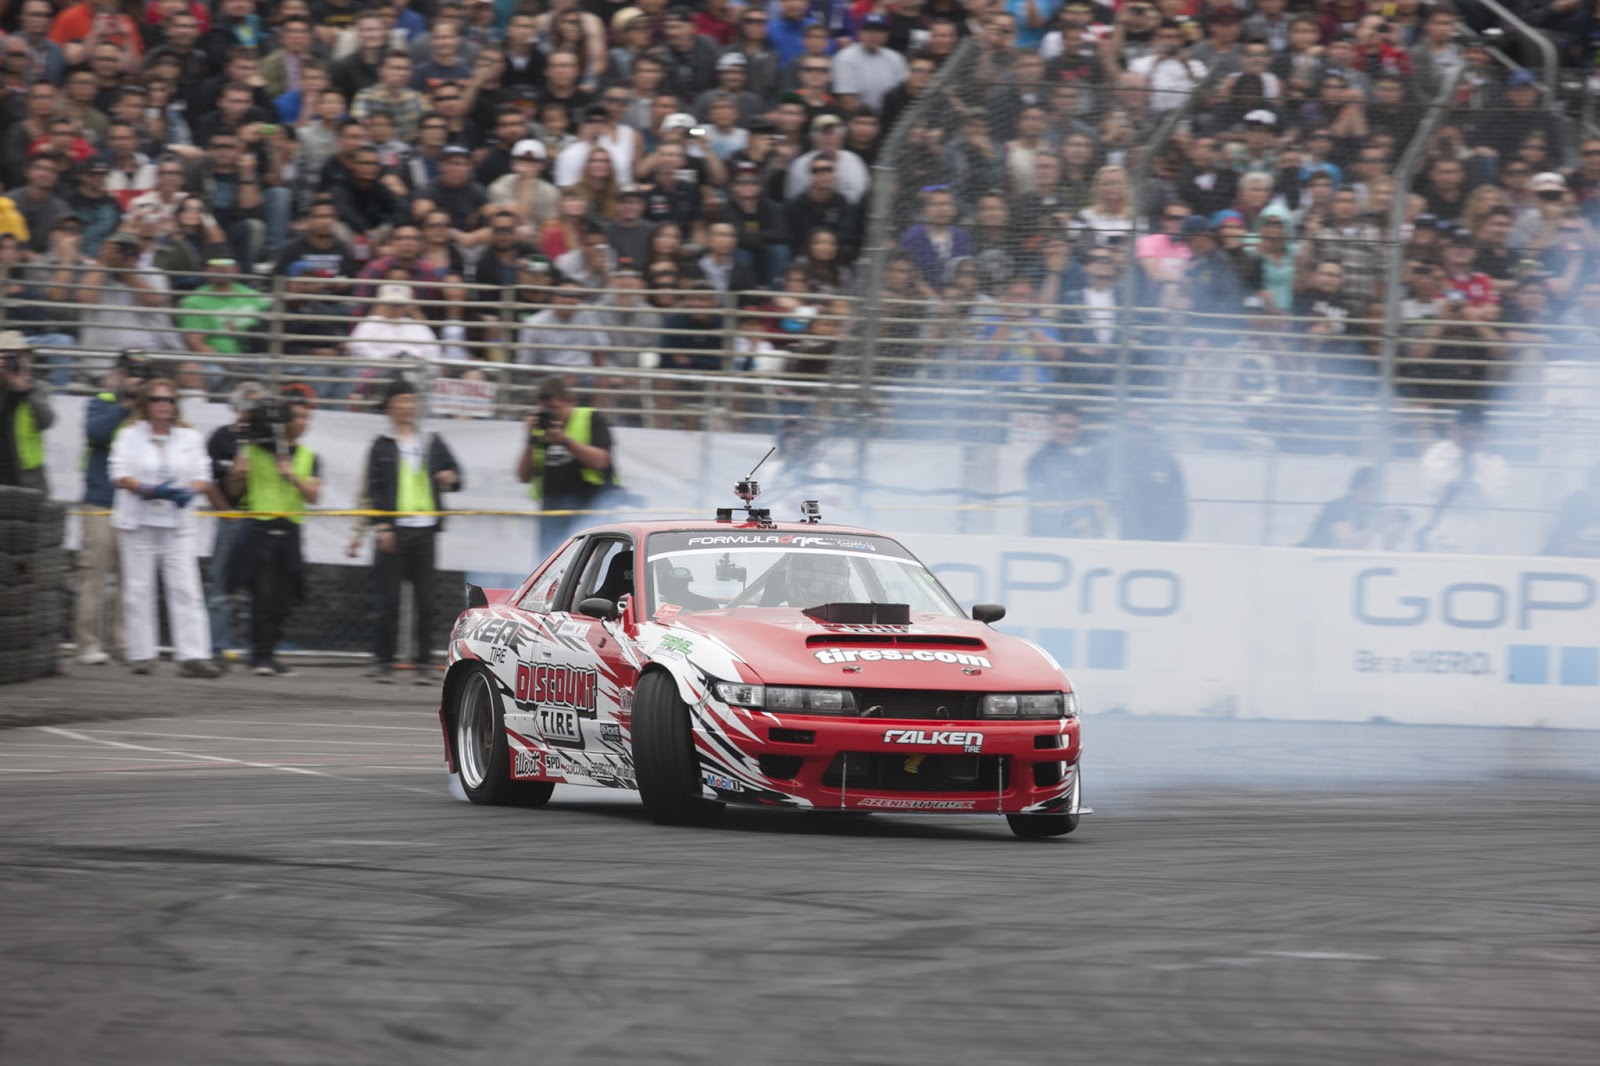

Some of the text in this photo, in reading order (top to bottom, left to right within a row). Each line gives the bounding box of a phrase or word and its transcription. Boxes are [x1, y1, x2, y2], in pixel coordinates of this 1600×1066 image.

[489, 647, 507, 664] TIRE
[814, 647, 992, 668] tires.com
[515, 660, 597, 714] DISCOUNT
[541, 710, 576, 737] TIRE
[883, 730, 984, 746] FALKEN
[964, 744, 982, 754] TIRE
[546, 756, 560, 769] SPD
[707, 774, 731, 791] Mobil
